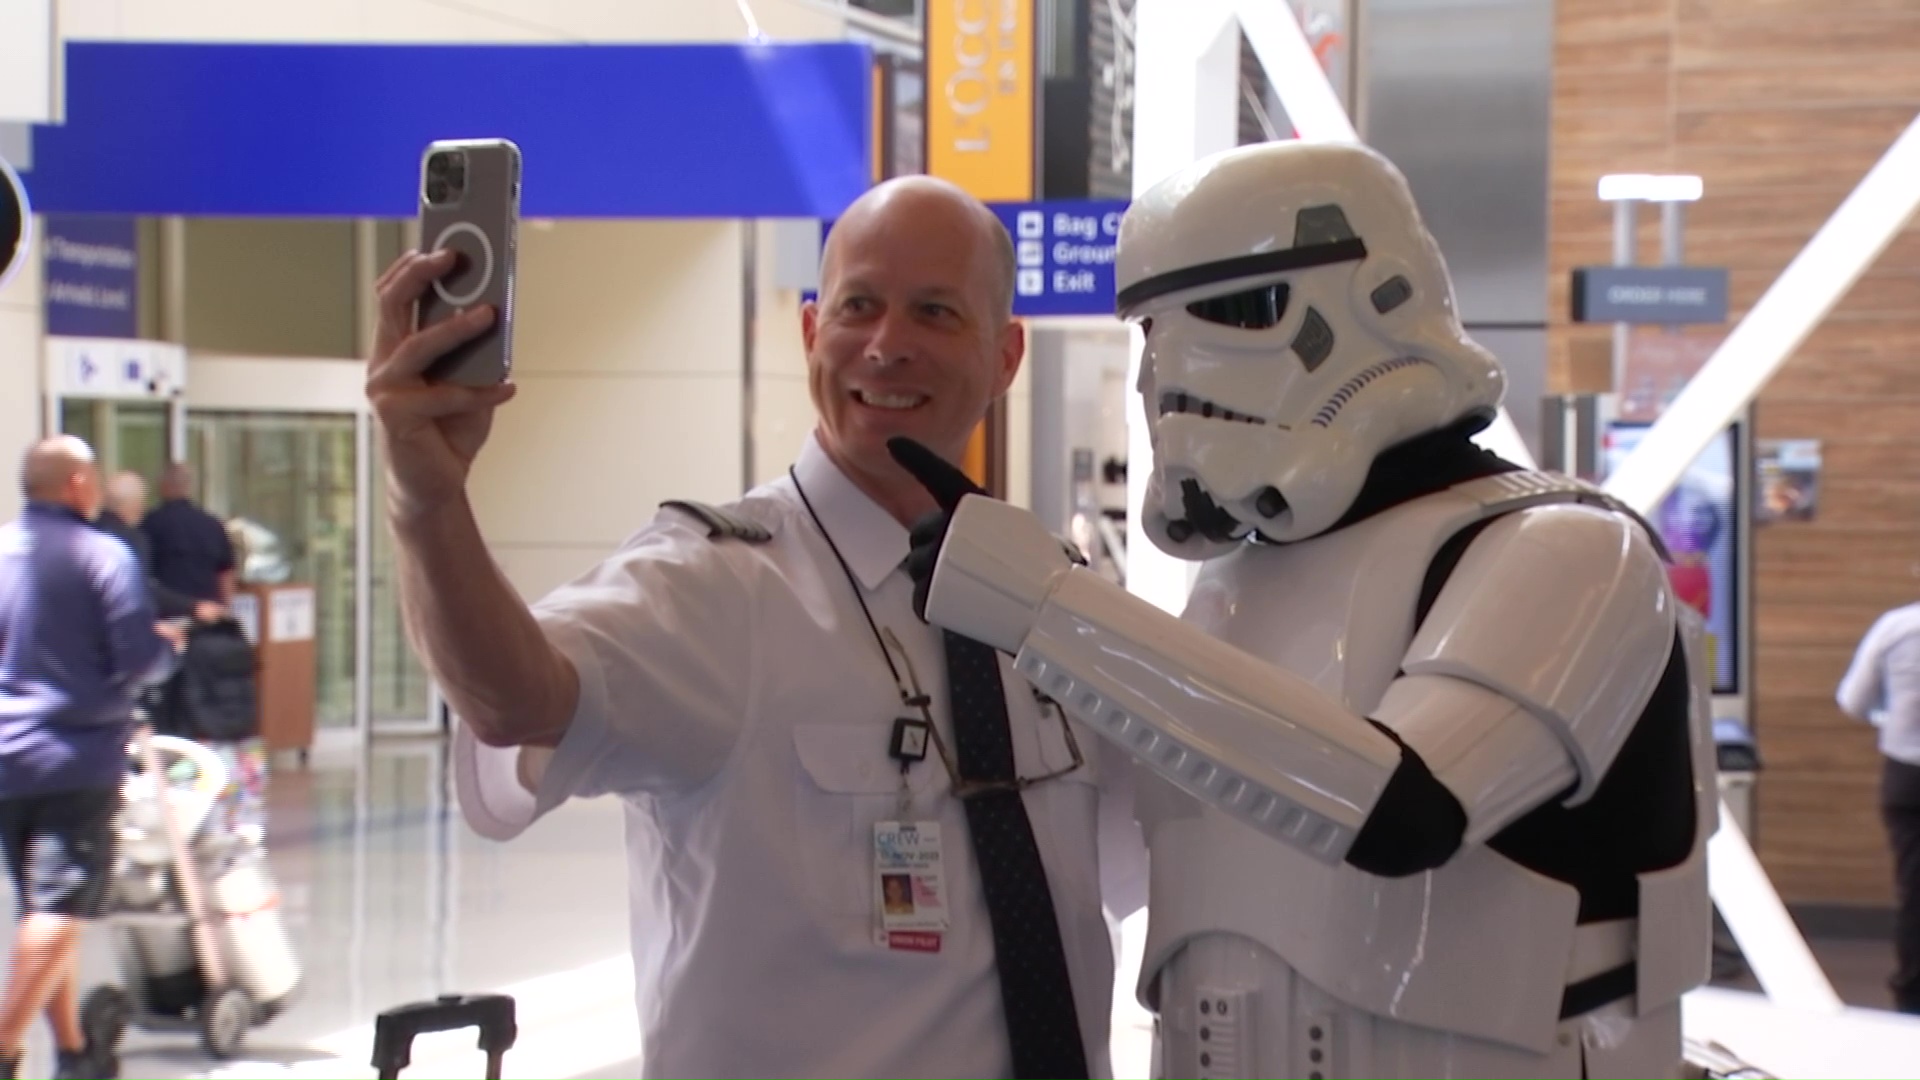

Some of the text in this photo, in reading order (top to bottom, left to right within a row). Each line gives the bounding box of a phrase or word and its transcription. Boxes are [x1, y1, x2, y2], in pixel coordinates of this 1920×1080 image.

[945, 0, 991, 153] L'OCC
[1053, 212, 1121, 242] Bag C
[1053, 241, 1117, 265] Groun
[1053, 269, 1096, 293] Exit
[877, 831, 920, 846] CREW
